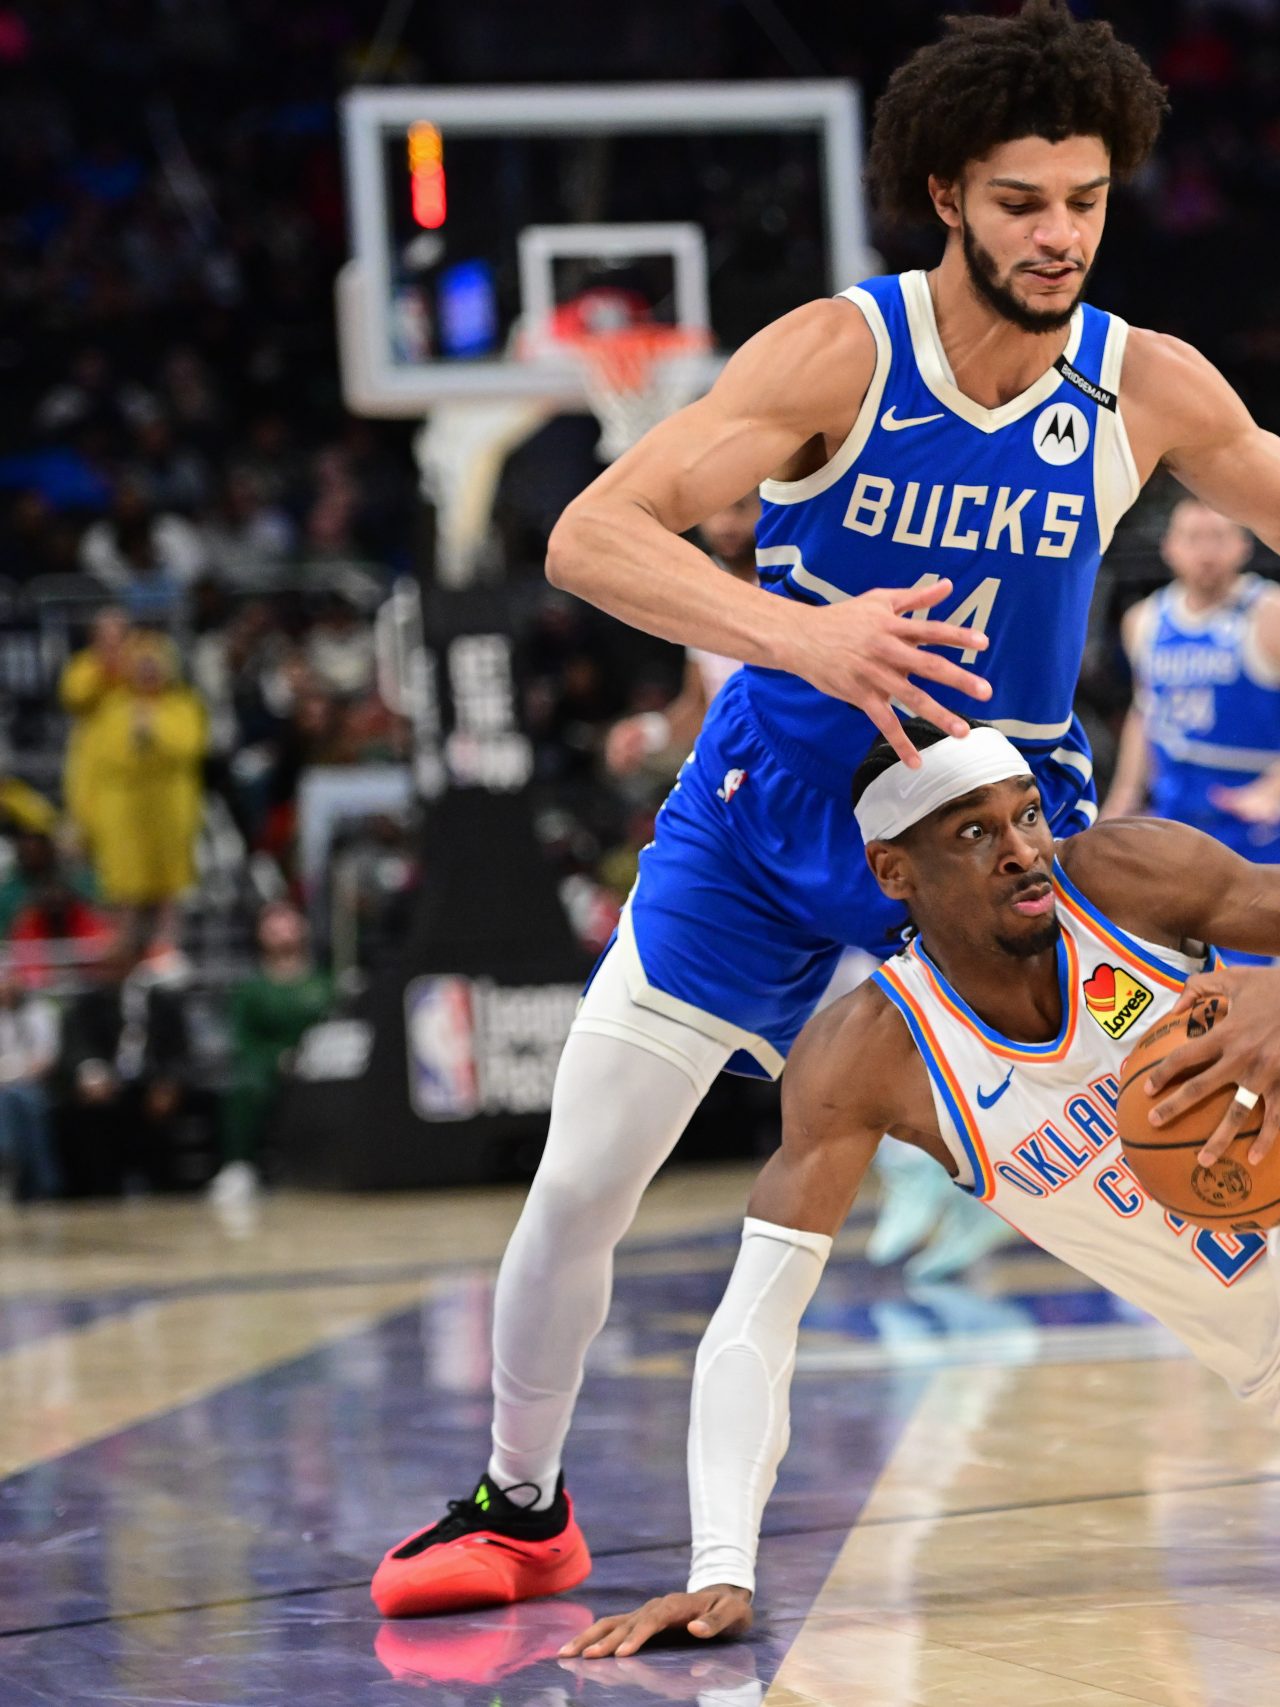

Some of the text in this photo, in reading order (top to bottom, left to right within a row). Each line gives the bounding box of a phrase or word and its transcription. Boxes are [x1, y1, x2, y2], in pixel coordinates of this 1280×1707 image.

[1061, 364, 1110, 404] BRIDGEMAN
[842, 473, 1085, 559] BUCKS
[994, 1072, 1121, 1199] OKLAH
